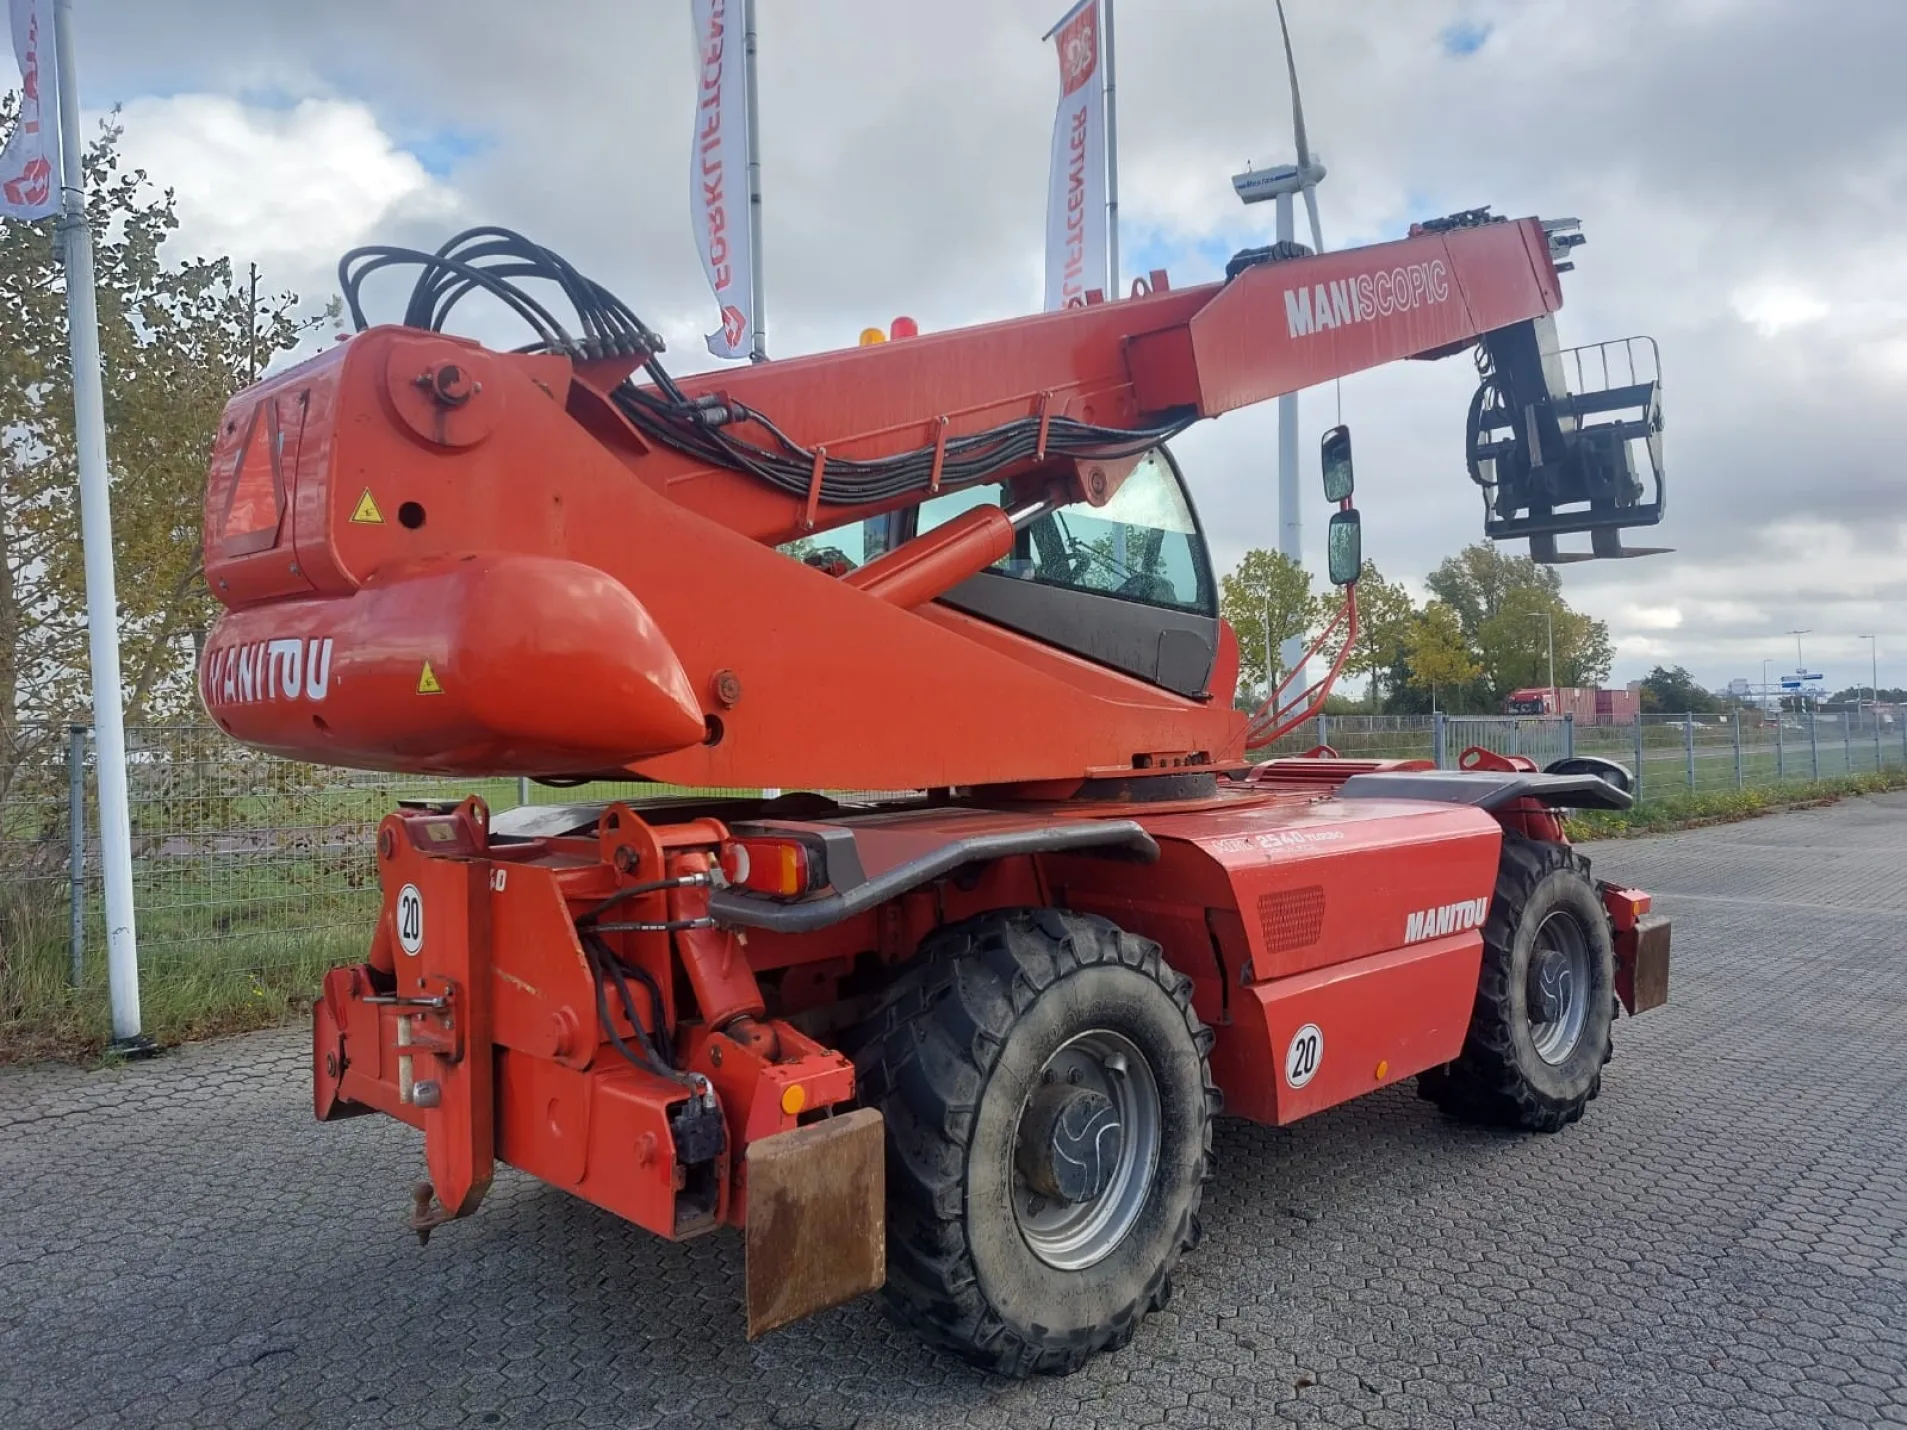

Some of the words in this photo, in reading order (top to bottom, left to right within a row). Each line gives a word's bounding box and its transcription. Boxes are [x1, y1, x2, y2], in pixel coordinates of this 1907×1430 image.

[1284, 259, 1449, 339] MANISCOPIC
[208, 638, 334, 706] MANITOU
[1255, 831, 1305, 849] 2540
[402, 895, 420, 940] 20
[1404, 896, 1488, 945] MANITOU
[1292, 1034, 1317, 1079] 20
